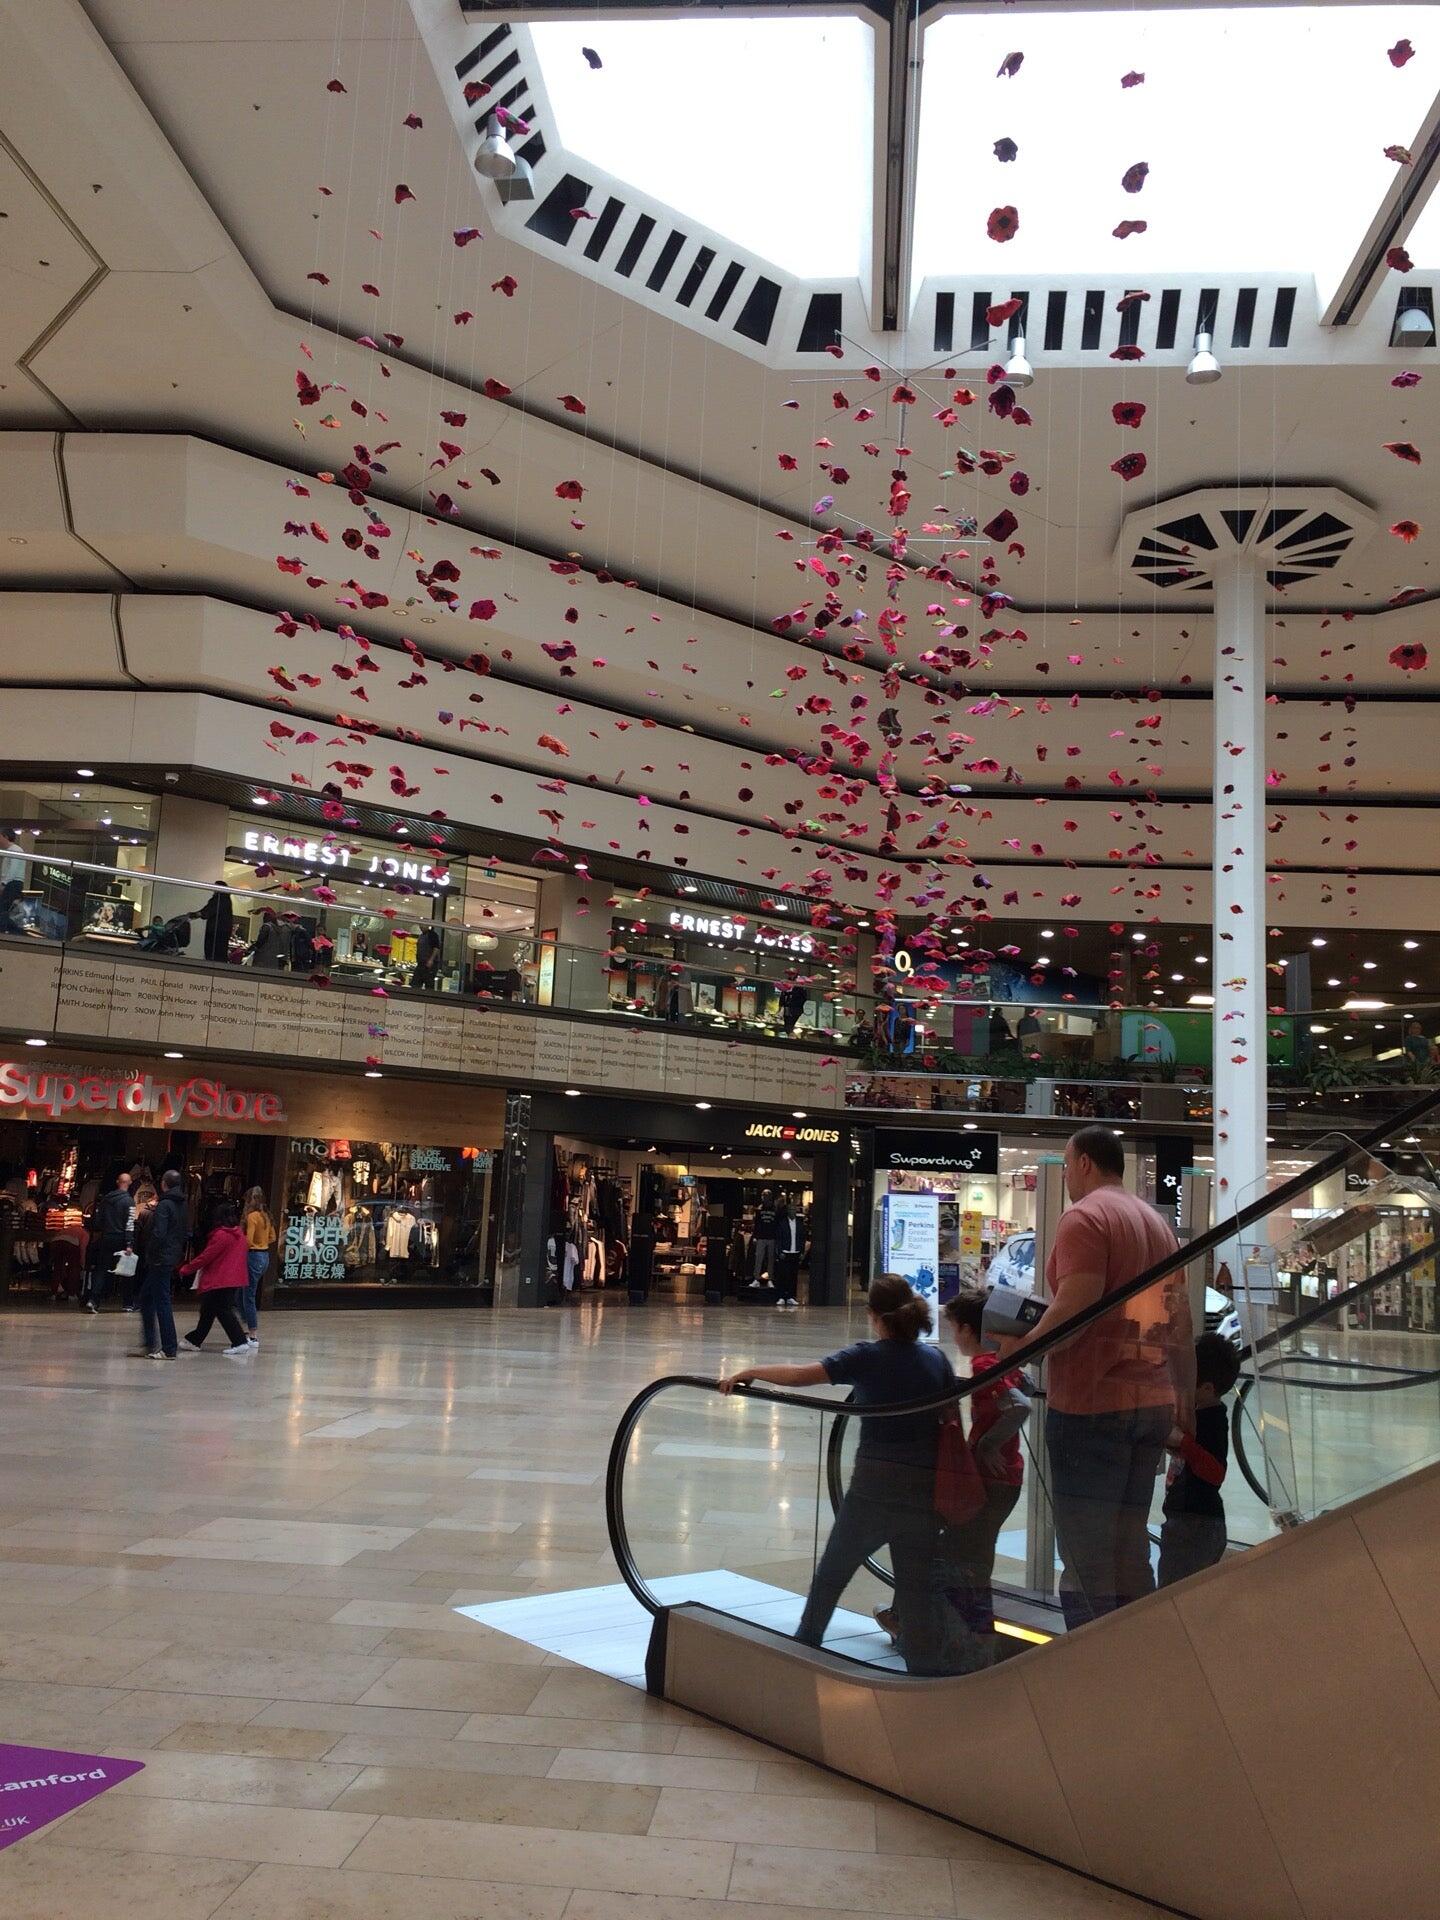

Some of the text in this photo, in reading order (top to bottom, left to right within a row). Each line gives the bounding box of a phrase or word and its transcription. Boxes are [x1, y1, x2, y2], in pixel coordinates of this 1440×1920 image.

[245, 831, 350, 867] ERNEST
[670, 912, 745, 940] ERNEST
[53, 967, 84, 977] PARKINS
[85, 971, 114, 981] Edmund
[115, 974, 135, 984] Lloyd
[140, 978, 158, 986] PAUL
[160, 980, 183, 989] Donald
[211, 986, 231, 995] Arthur
[232, 989, 256, 998] William
[51, 982, 78, 991] RIPON
[79, 985, 105, 995] Charles
[106, 988, 131, 997] William
[138, 992, 173, 1003] ROBINSON
[174, 997, 197, 1006] Horace
[238, 1004, 262, 1013] Thomas
[81, 1001, 106, 1010] Joseph
[107, 1004, 128, 1013] Henry
[134, 1006, 157, 1015] SNOW
[158, 1009, 173, 1017] John
[175, 1012, 195, 1020] Henry
[745, 1123, 840, 1143] JACK JONES
[410, 1163, 452, 1171] EXCLUSIVE
[411, 1156, 447, 1164] STUDENT
[890, 1153, 975, 1170] Superdrug
[288, 1215, 343, 1228] THIS IS MY
[908, 1221, 935, 1229] Perkins
[285, 1226, 349, 1246] SUPER
